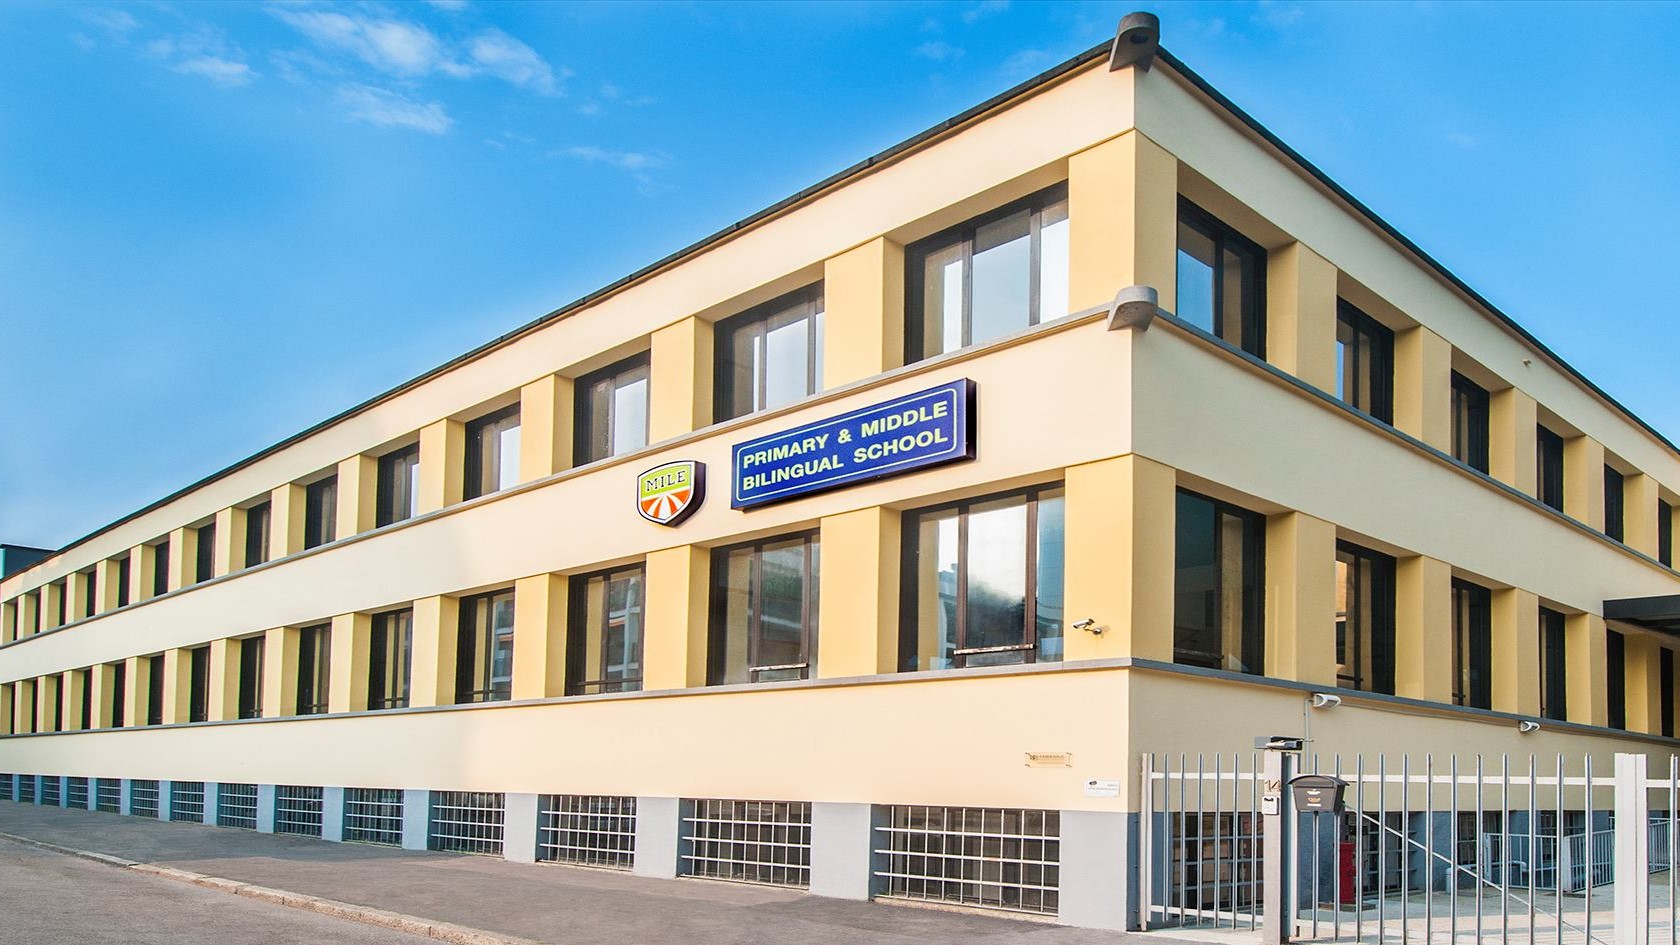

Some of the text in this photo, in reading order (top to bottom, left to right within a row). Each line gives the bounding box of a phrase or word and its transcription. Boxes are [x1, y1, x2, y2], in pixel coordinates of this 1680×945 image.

[743, 400, 948, 469] PRIMARY & MIDDLE
[743, 428, 948, 491] BILINGUAL SCHOOL
[646, 470, 686, 491] MILE
